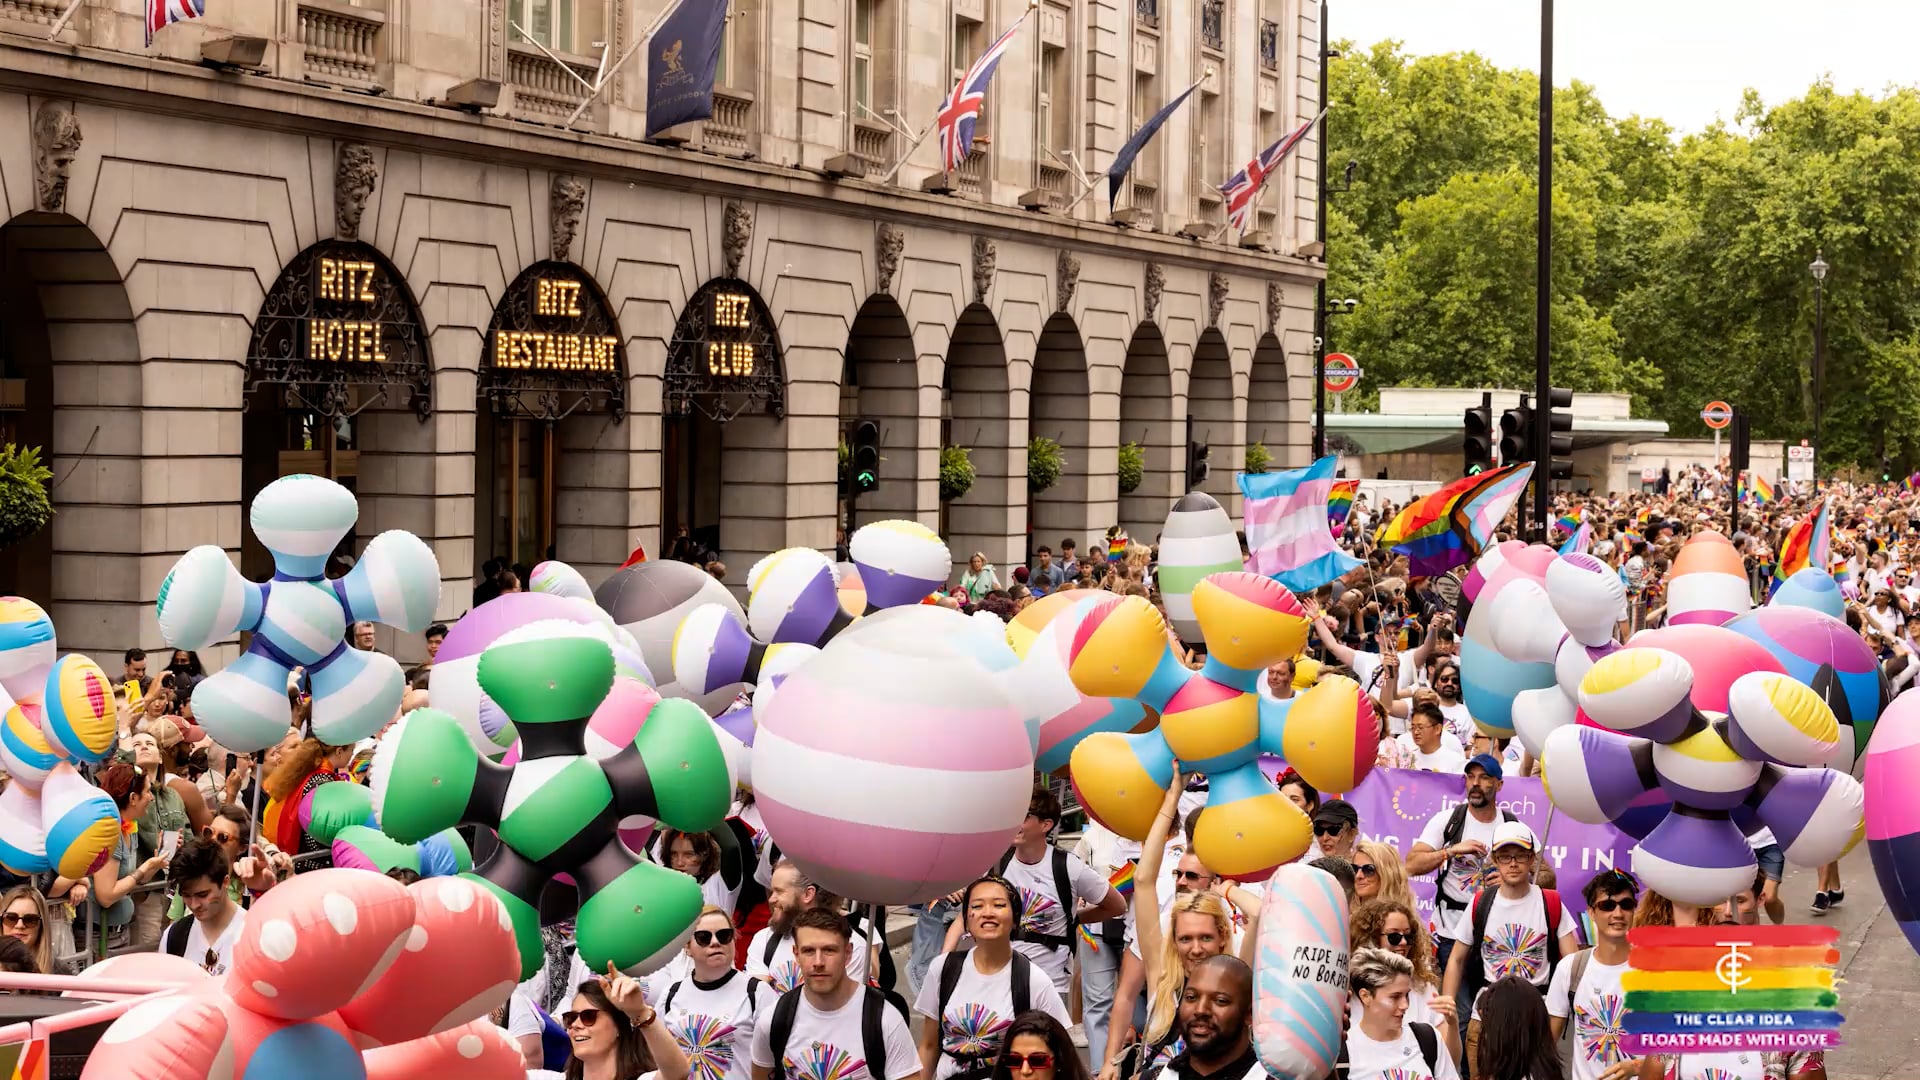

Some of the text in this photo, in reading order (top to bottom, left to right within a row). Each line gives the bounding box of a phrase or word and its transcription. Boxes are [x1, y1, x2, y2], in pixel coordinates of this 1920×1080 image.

[321, 258, 375, 302] RITZ
[539, 279, 581, 316] RITZ
[715, 293, 750, 327] RITZ
[311, 319, 386, 362] HOTEL
[497, 331, 617, 371] RESTAURANT
[709, 341, 753, 376] CLUB
[1582, 847, 1614, 871] IN
[1292, 965, 1309, 979] NO
[1293, 946, 1348, 969] PRIDE HA
